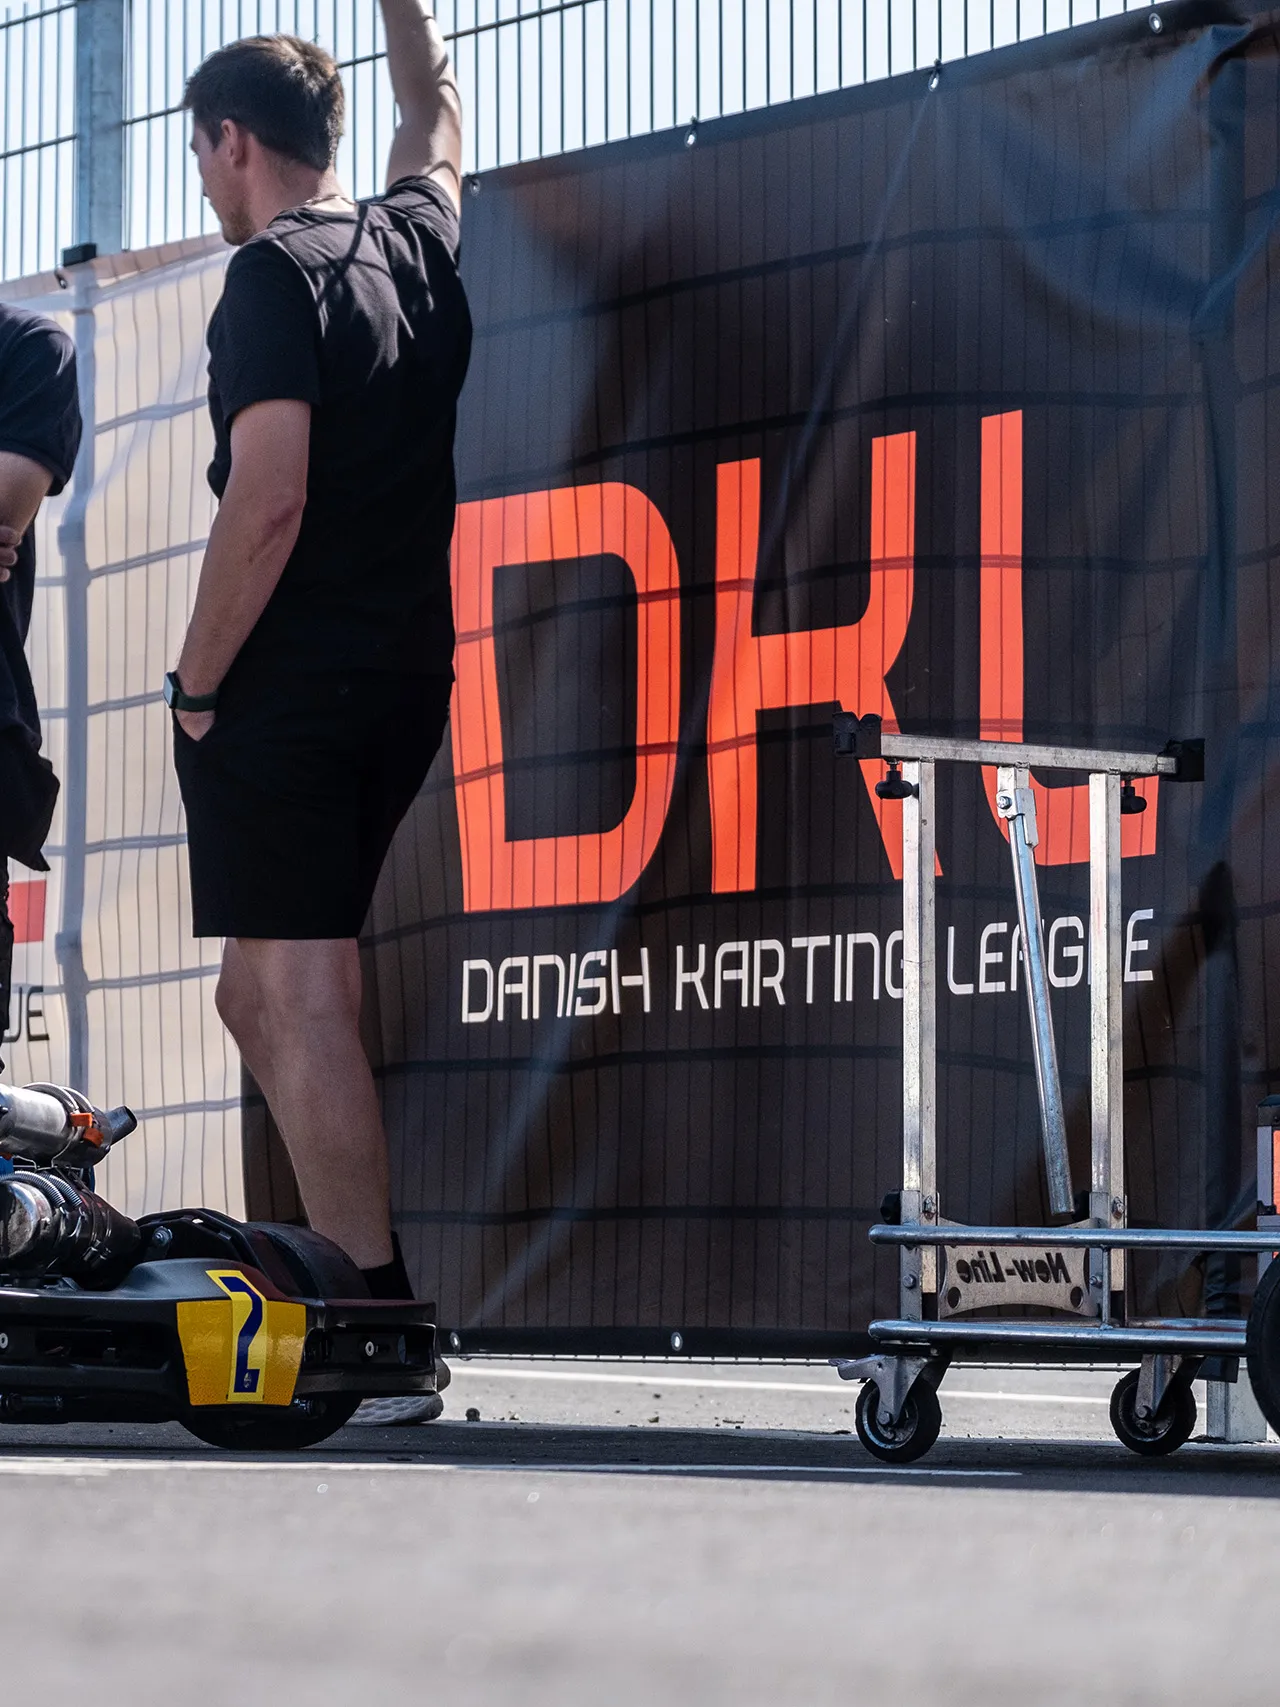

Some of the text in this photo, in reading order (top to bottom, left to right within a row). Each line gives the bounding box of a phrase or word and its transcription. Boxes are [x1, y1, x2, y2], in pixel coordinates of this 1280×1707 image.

[450, 410, 1159, 912] DKL
[462, 946, 652, 1024] DANISH
[947, 908, 1154, 995] LEGE
[218, 1276, 264, 1394] 2
